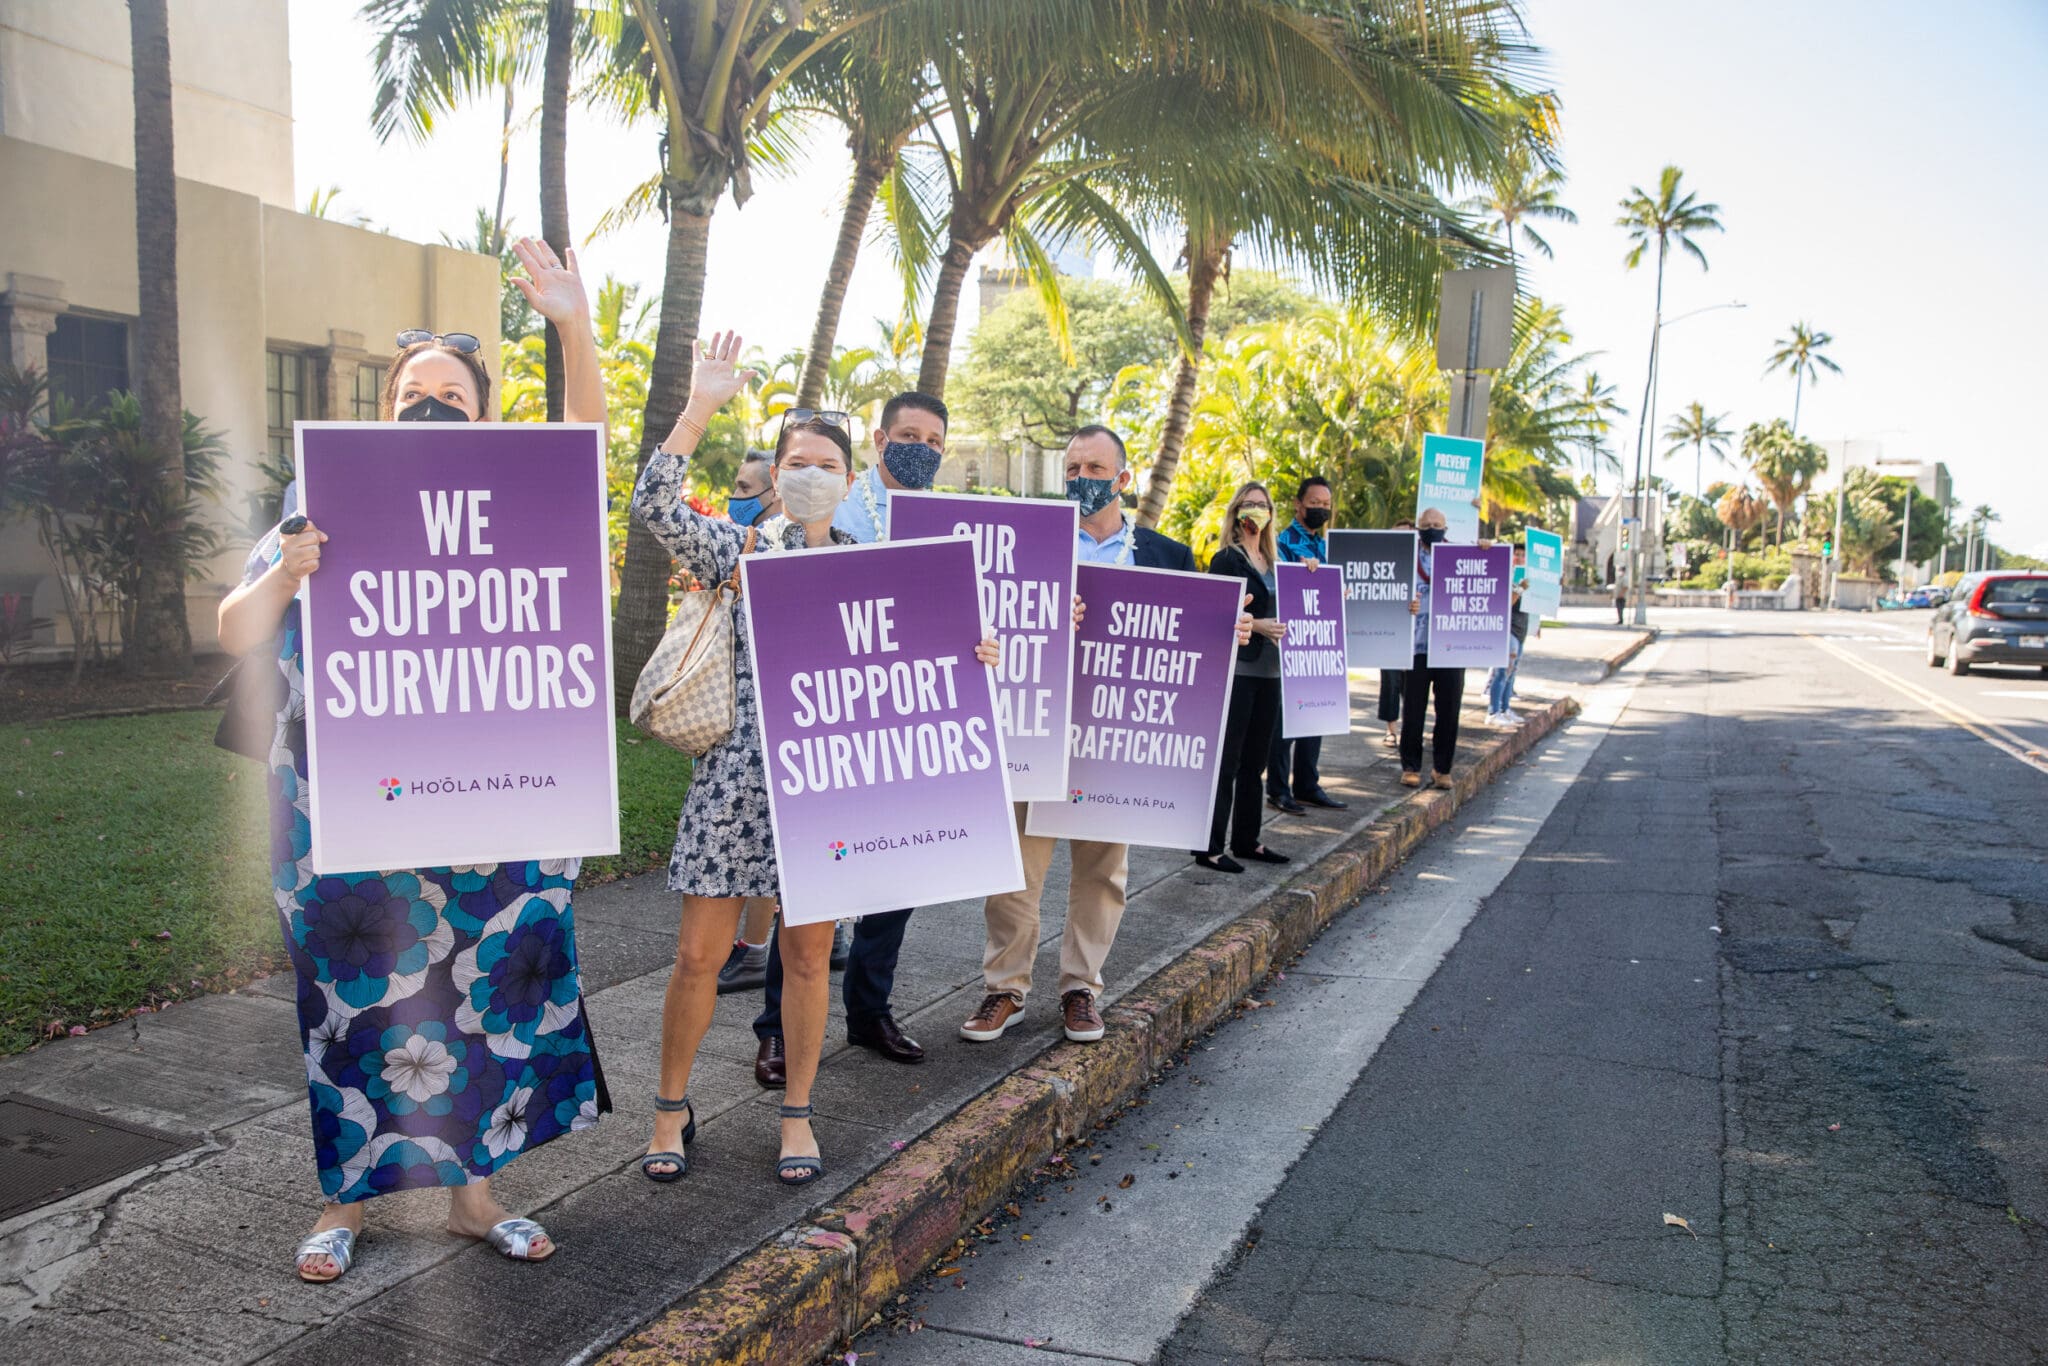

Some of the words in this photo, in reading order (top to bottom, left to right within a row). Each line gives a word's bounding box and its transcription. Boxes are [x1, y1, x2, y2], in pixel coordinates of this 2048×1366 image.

[1434, 452, 1471, 471] PREVENT
[419, 490, 493, 556] WE
[953, 522, 1016, 574] UR
[1346, 561, 1370, 580] END
[1372, 561, 1396, 580] SEX
[1455, 558, 1488, 576] SHINE
[350, 567, 568, 637] SUPPORT
[1302, 589, 1321, 616] WE
[1343, 582, 1408, 601] AFFICKING
[1444, 577, 1465, 594] THE
[1467, 578, 1498, 594] LIGHT
[980, 579, 1060, 630] DREN
[1108, 601, 1183, 642] SHINE
[1451, 596, 1467, 612] ON
[1469, 596, 1489, 613] SEX
[839, 597, 899, 656] WE
[1287, 619, 1337, 646] SUPPORT
[1435, 614, 1504, 631] TRAFFICKING
[1080, 640, 1126, 678] THE
[1130, 646, 1202, 686] LIGHT
[1284, 649, 1344, 677] SURVIVORS
[326, 644, 596, 718] SURVIVORS
[791, 656, 958, 728] SUPPORT
[999, 688, 1052, 737] ALE
[1091, 684, 1126, 720] ON
[1131, 688, 1179, 726] SEX
[778, 716, 992, 795] SURVIVORS
[1070, 724, 1206, 770] RAFFICKING
[487, 774, 514, 790] NĀ
[519, 775, 556, 789] PUA
[1152, 799, 1175, 810] PUA
[938, 828, 968, 841] PUA
